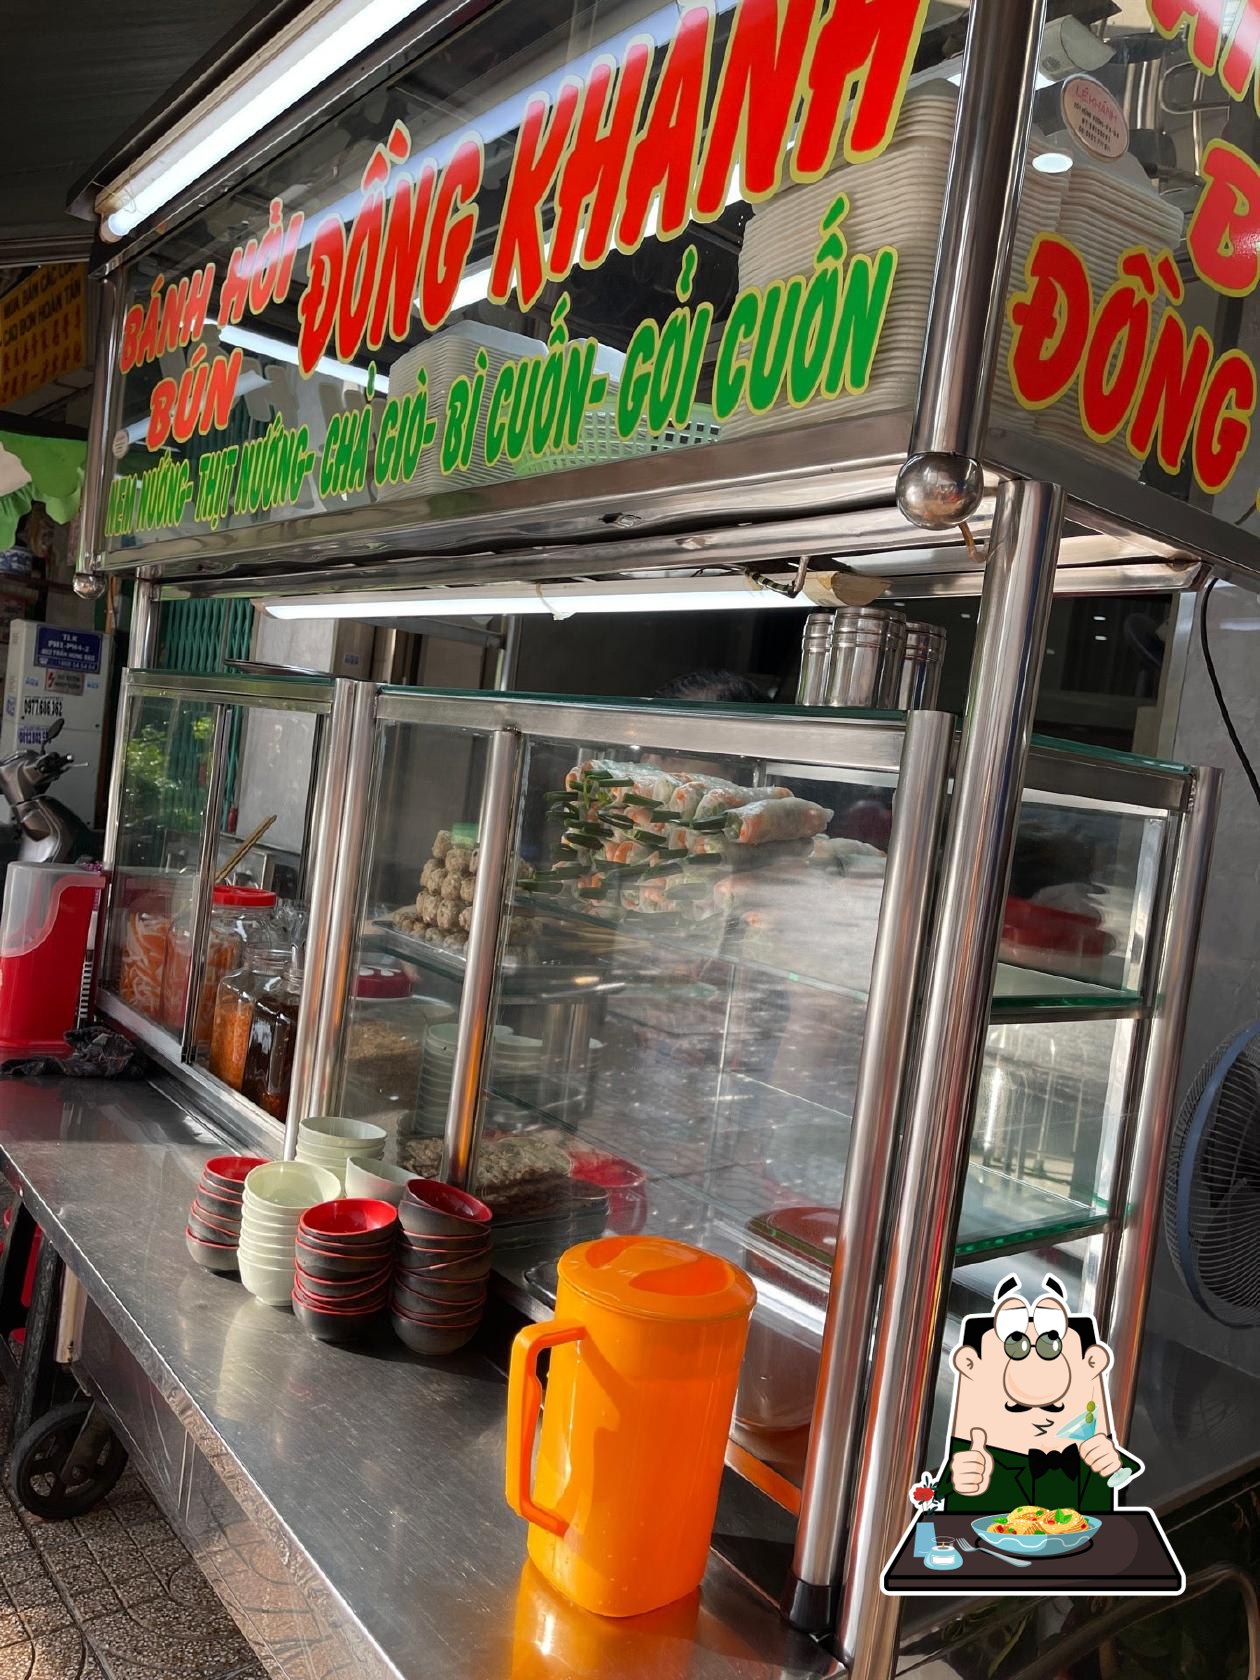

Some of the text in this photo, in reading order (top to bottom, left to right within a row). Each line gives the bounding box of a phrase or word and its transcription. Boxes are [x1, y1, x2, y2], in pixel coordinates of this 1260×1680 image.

[120, 263, 216, 374] BÁNH
[217, 198, 304, 329] HỎI
[300, 119, 484, 379] ĐỒNG
[319, 361, 376, 499] CHẢ
[440, 347, 488, 475] BÌ
[615, 244, 714, 441] GỎI
[712, 191, 898, 422] CUỐN
[1007, 232, 1257, 494] ĐỒNG
[146, 343, 243, 452] BÚN
